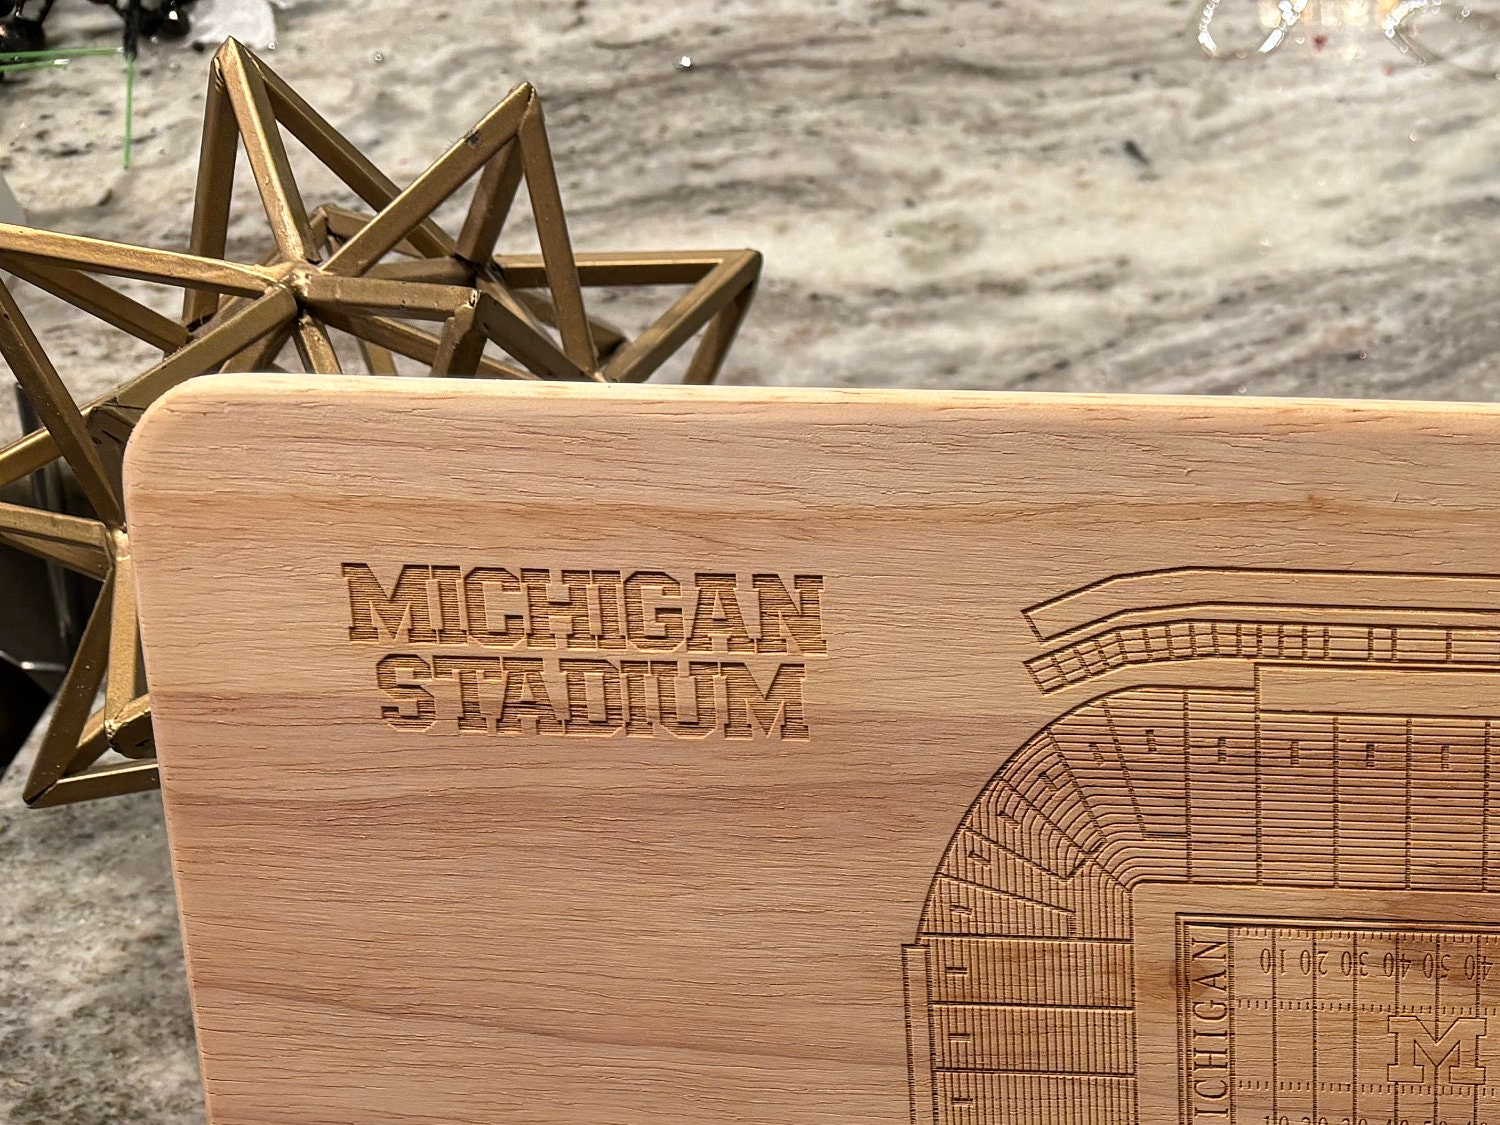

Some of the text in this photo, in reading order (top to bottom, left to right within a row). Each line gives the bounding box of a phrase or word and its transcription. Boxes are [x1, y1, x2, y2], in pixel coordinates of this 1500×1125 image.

[341, 562, 829, 656] MICHIGAN
[376, 653, 811, 742] STADIUM
[1387, 1014, 1487, 1085] M
